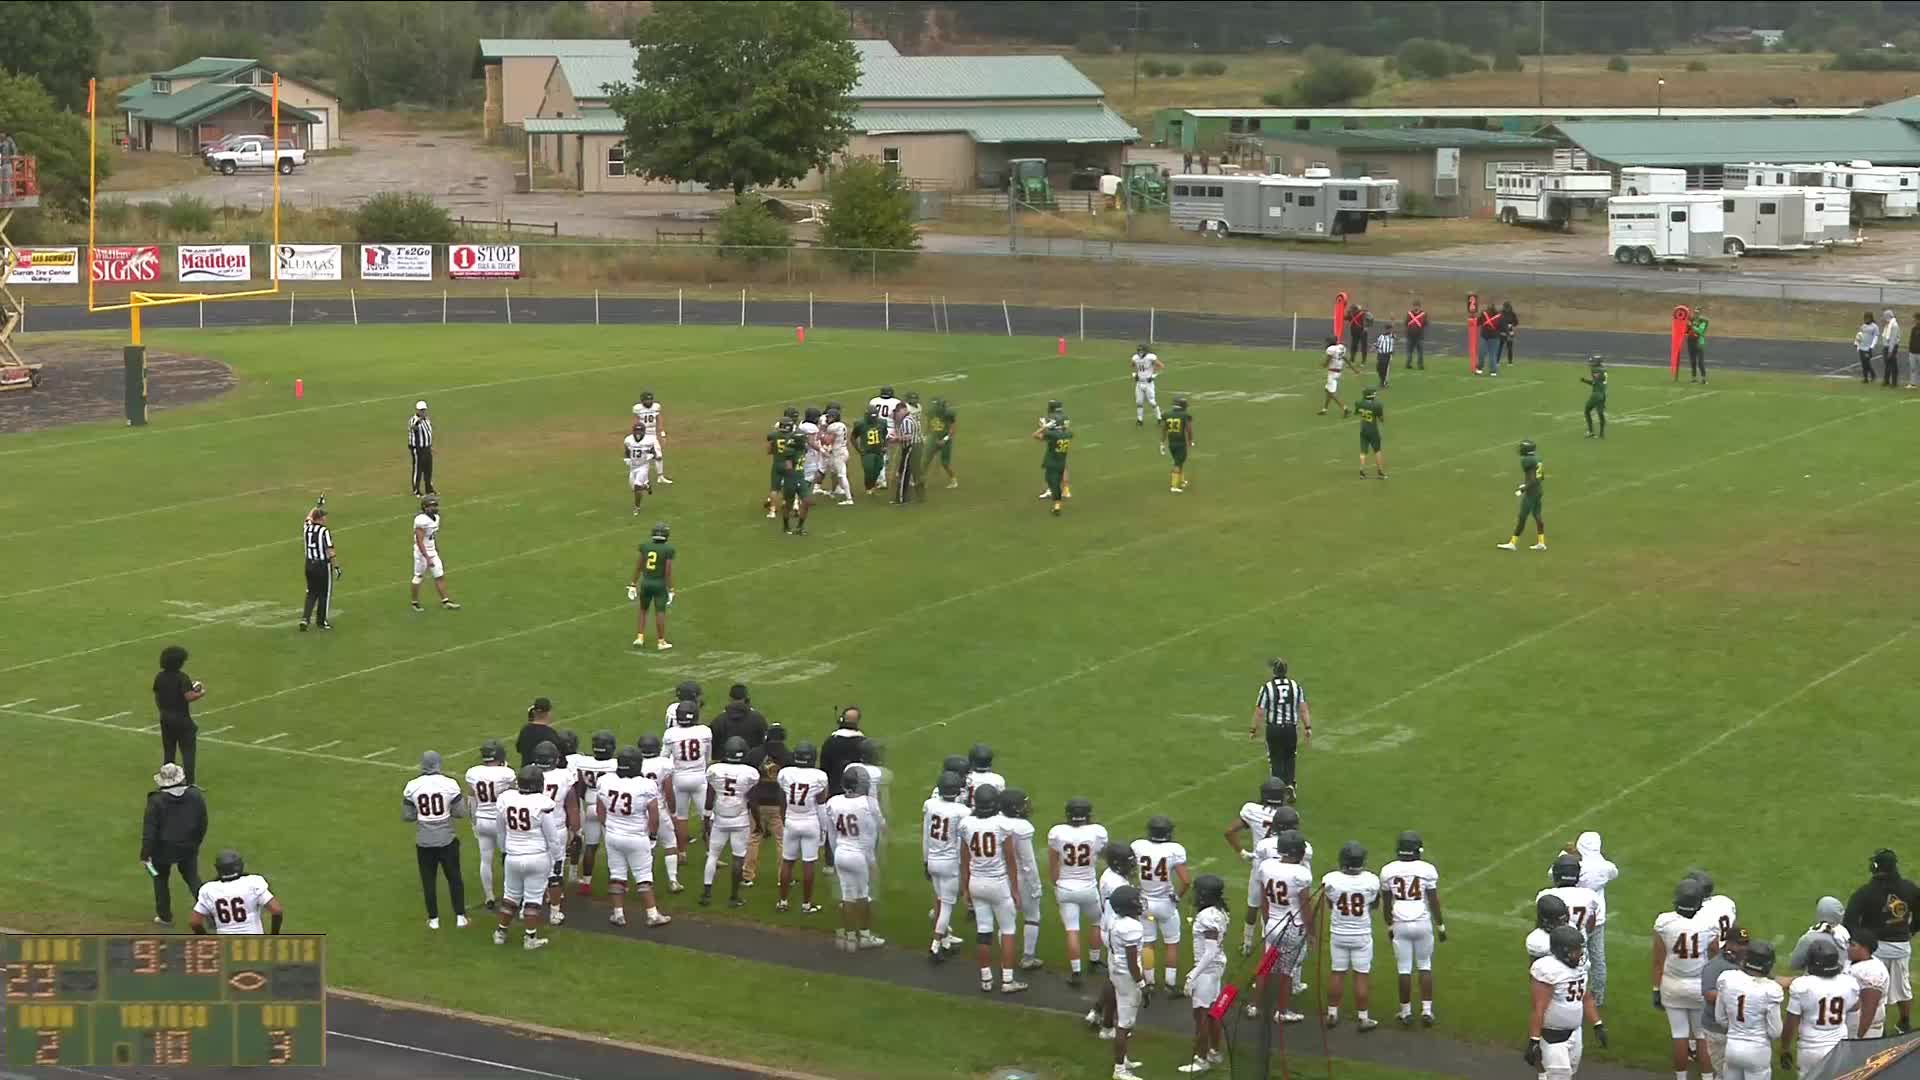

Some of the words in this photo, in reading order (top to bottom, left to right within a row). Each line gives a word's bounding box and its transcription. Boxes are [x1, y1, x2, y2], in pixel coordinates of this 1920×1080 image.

[182, 253, 246, 269] Madden
[477, 246, 516, 261] STOP
[92, 260, 155, 281] SIGNS
[867, 429, 881, 446] 91
[1166, 418, 1181, 433] 33
[308, 532, 316, 547] L
[646, 551, 657, 570] 2
[1277, 685, 1290, 703] F
[679, 739, 700, 762] 18
[476, 780, 497, 803] 81
[724, 778, 736, 797] 5
[789, 783, 810, 807] 17
[417, 792, 444, 816] 80
[608, 790, 632, 816] 73
[506, 806, 531, 831] 69
[835, 813, 860, 837] 46
[930, 815, 950, 842] 21
[969, 831, 997, 858] 40
[1063, 843, 1091, 867] 32
[1140, 855, 1168, 882] 24
[1264, 878, 1290, 907] 42
[1391, 876, 1422, 901] 34
[215, 896, 247, 924] 66
[1336, 892, 1365, 917] 48
[1673, 932, 1700, 960] 41
[1566, 979, 1586, 1002] 55
[1736, 994, 1746, 1023] 1
[1816, 996, 1845, 1026] 19
